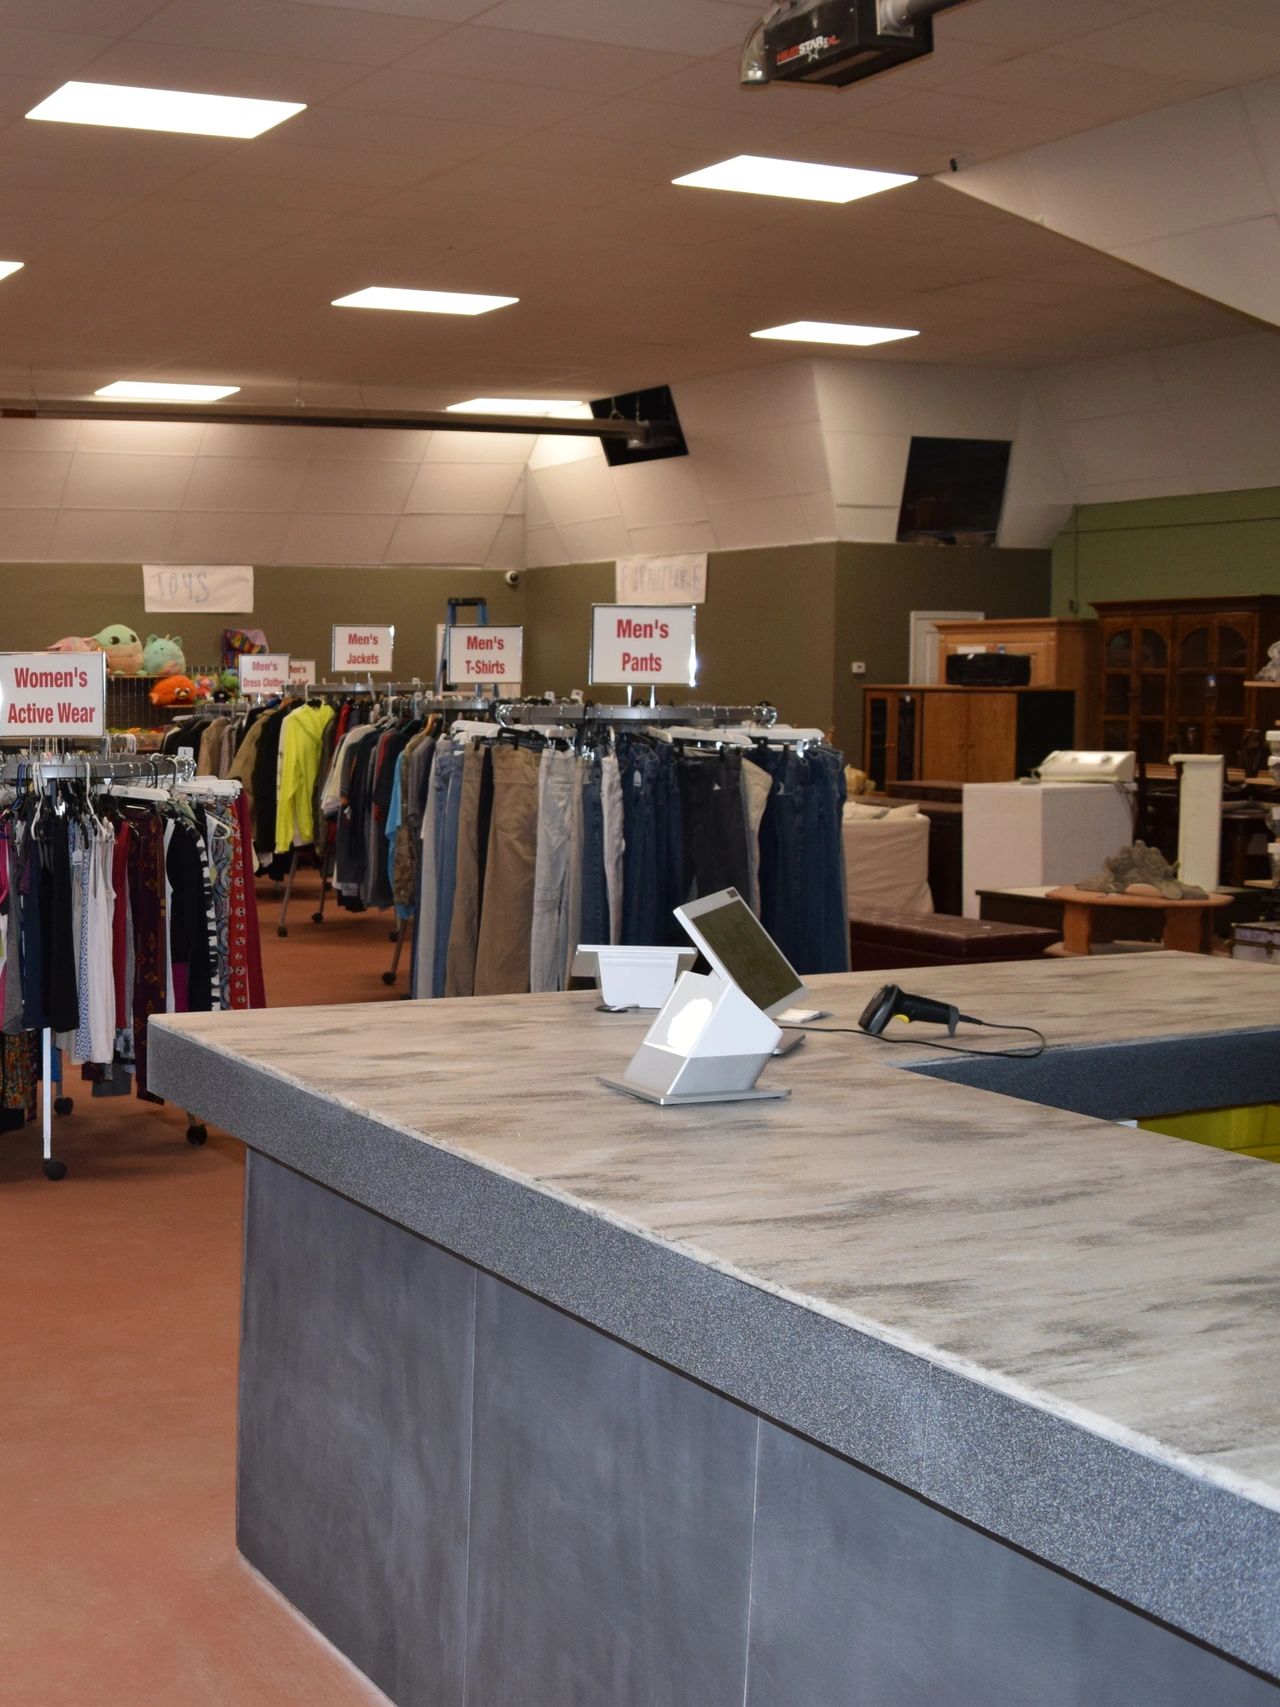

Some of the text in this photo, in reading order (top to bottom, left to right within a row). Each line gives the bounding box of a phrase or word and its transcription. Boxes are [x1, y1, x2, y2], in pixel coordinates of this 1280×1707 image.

[150, 571, 210, 603] TOYS
[616, 619, 669, 639] Men's
[348, 633, 379, 645] Men's
[466, 636, 505, 650] Men's
[252, 661, 278, 671] Men's
[346, 652, 379, 665] Jackets
[622, 652, 662, 672] Pants
[465, 660, 505, 675] T-Shirts
[14, 668, 88, 688] Women's
[243, 677, 261, 687] Dress
[263, 677, 284, 687] Clothe
[8, 703, 95, 724] Active Wear
